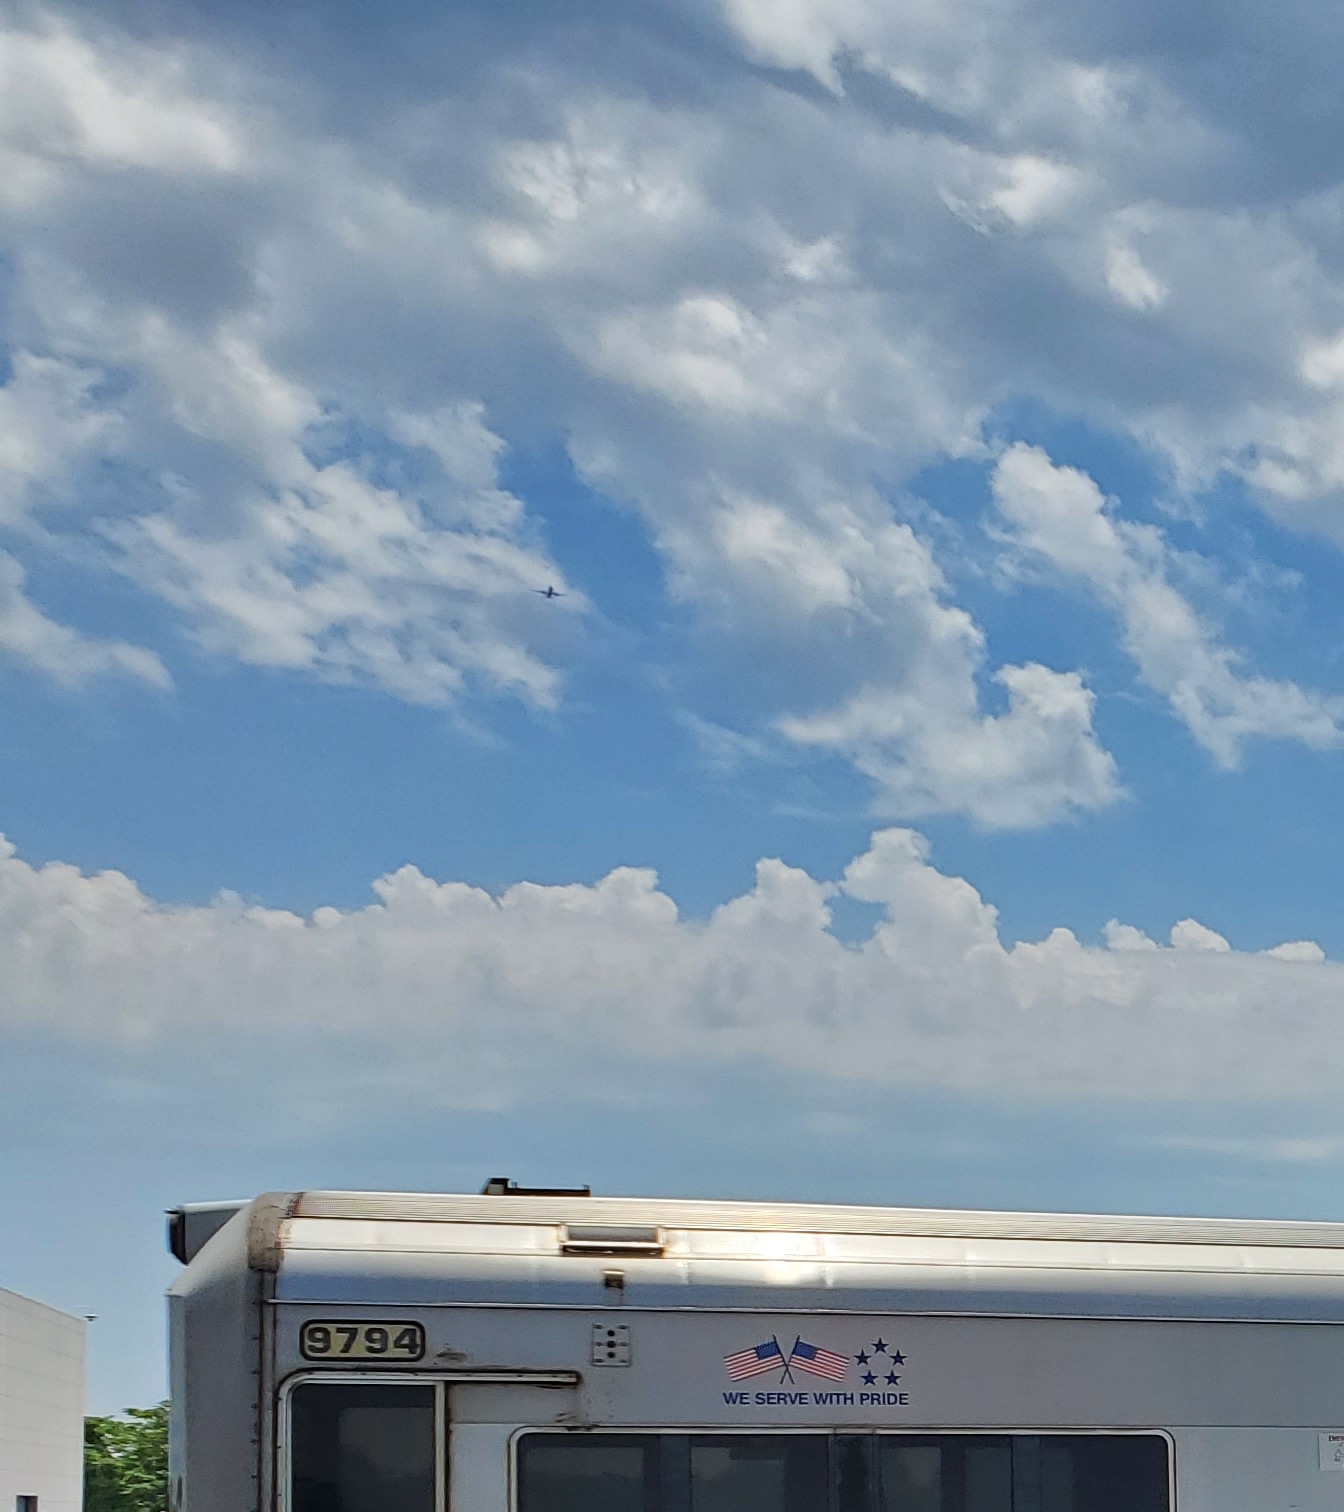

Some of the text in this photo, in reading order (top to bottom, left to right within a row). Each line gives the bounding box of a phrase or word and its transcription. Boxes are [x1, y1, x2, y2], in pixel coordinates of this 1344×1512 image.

[307, 1326, 420, 1354] 9794
[723, 1392, 909, 1406] WE SERVE WITH PRIDE
